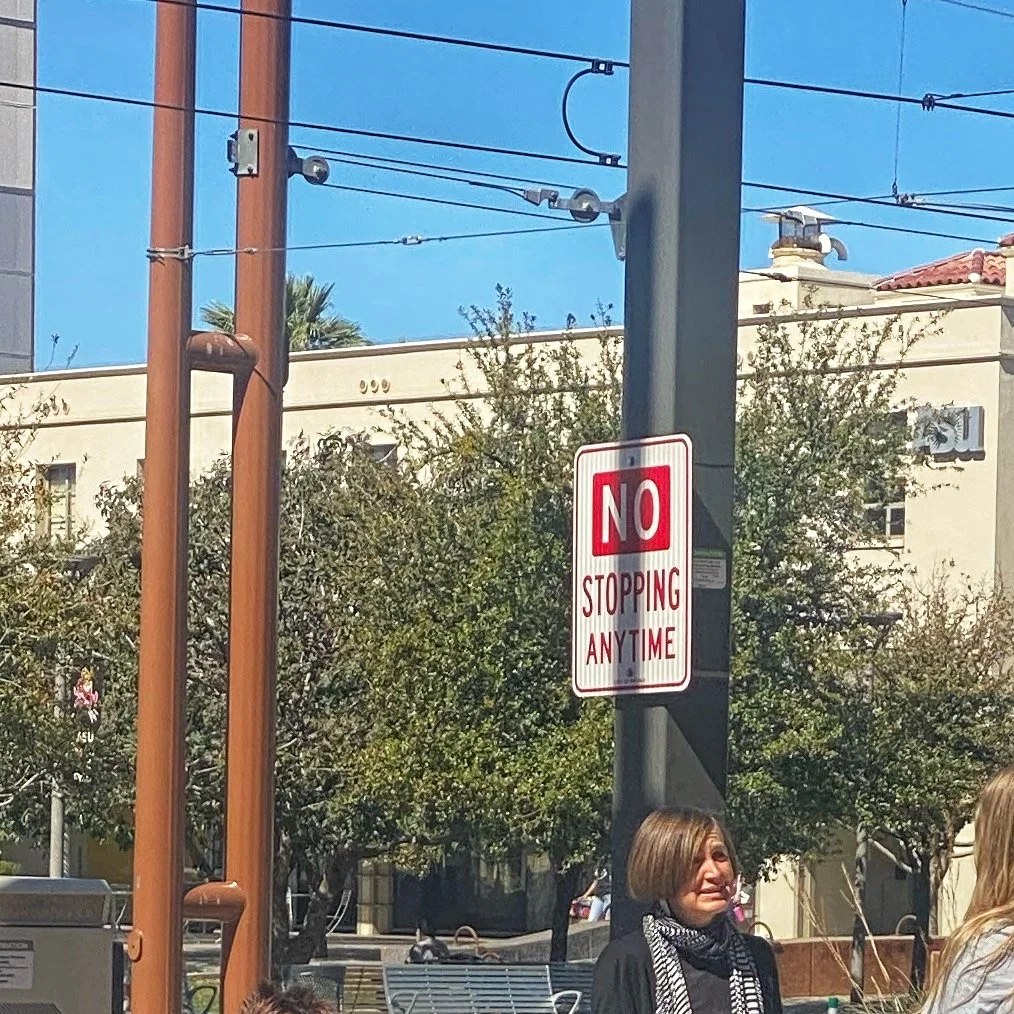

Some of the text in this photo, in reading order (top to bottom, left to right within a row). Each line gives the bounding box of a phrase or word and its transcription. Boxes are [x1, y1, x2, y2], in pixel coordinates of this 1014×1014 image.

[601, 479, 660, 543] NO
[582, 566, 680, 617] STOPPING
[586, 626, 676, 665] ANYTIME
